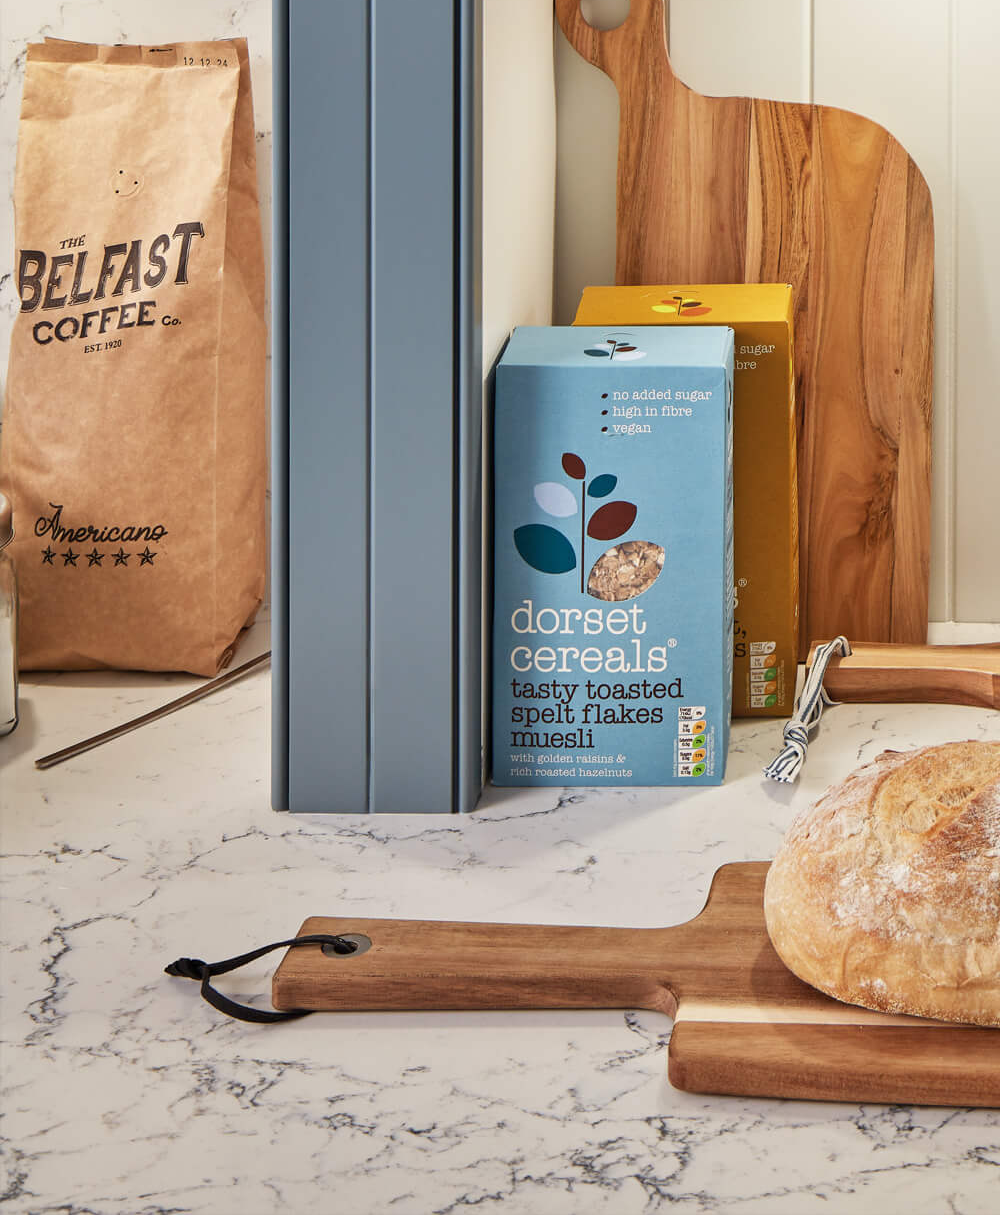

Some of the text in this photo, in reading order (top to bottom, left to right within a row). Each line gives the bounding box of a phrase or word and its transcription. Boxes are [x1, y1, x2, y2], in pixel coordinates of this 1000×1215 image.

[59, 234, 86, 250] THE
[19, 221, 206, 314] BELFAST
[32, 300, 182, 345] COFFEE Co.
[104, 339, 122, 351] 1920
[740, 344, 776, 356] sugar
[612, 389, 713, 403] no added sugar
[612, 405, 693, 418] high in fibre
[612, 423, 652, 435] vegan
[34, 502, 169, 543] Americano
[510, 600, 647, 635] dorset
[511, 678, 684, 704] tasty toasted
[511, 703, 664, 726] spelt flakes
[510, 728, 595, 749] muesli
[510, 753, 626, 765] with golden raisins &
[510, 767, 633, 777] rich roasted hazelnuts
